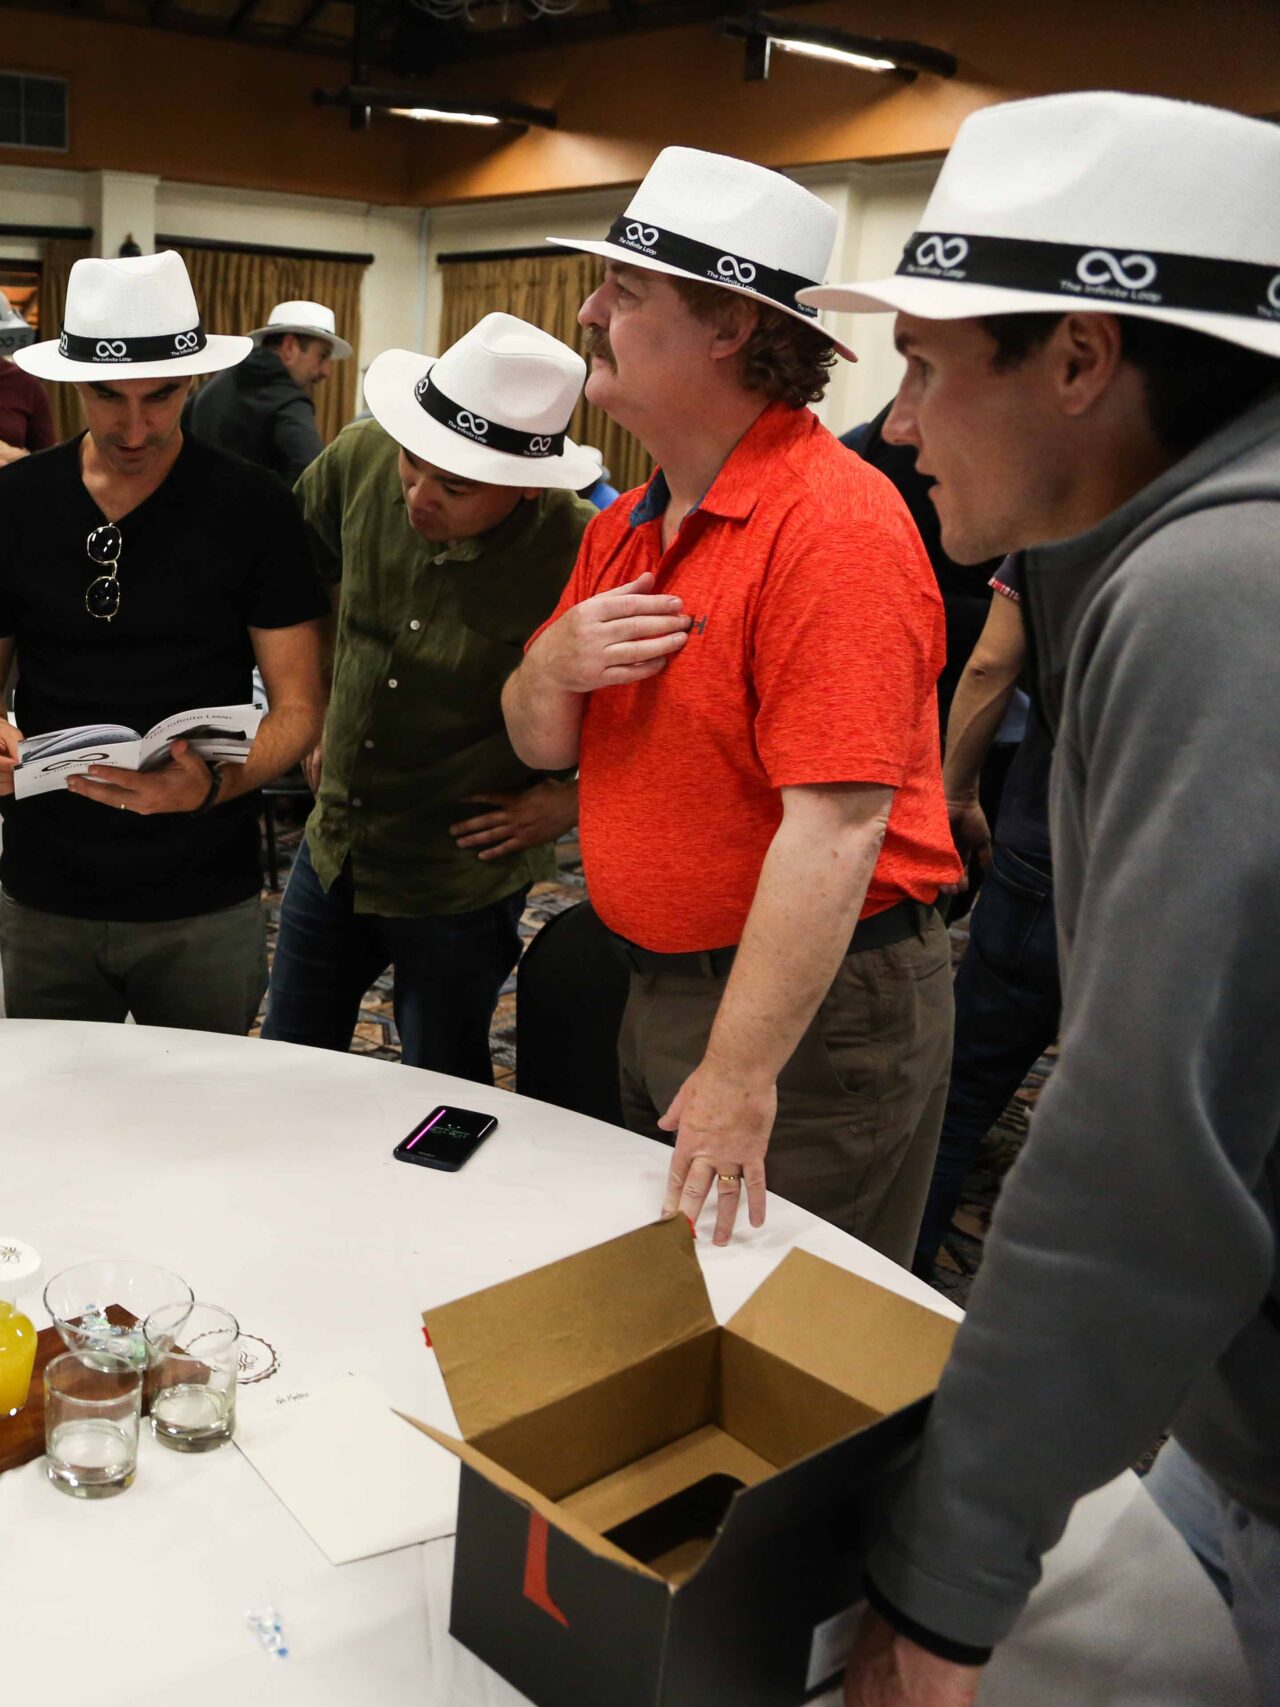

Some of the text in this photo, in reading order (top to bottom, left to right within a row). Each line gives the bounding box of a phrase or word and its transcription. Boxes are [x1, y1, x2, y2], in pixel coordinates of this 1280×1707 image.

[707, 269, 719, 279] The
[719, 274, 741, 287] Infinite
[1060, 279, 1163, 303] The Infinite Loop
[448, 419, 488, 444] The Infinite Loop
